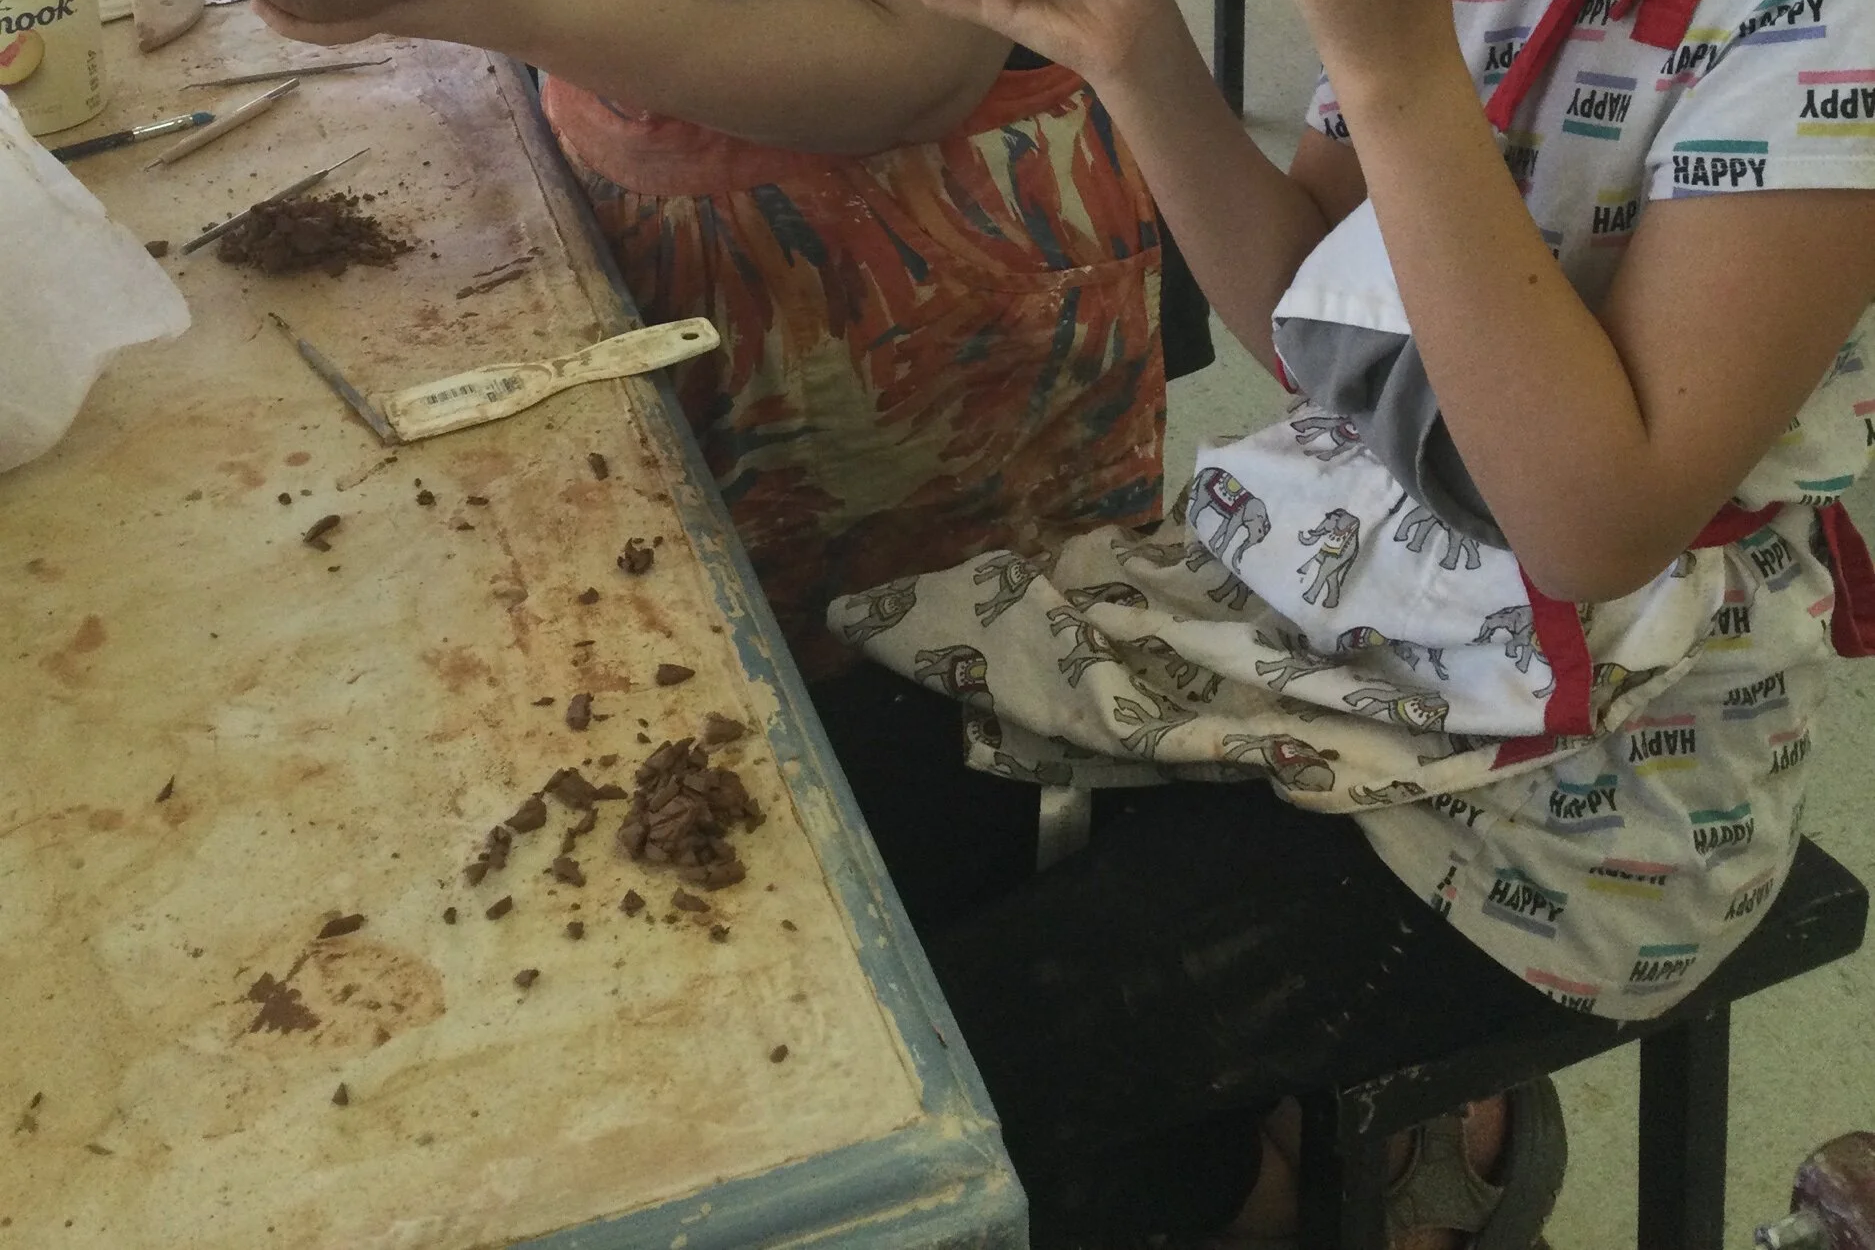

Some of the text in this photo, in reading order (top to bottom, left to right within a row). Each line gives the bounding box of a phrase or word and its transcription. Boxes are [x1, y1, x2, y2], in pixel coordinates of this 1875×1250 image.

[1567, 88, 1632, 122] HAPPY
[1800, 88, 1875, 118] APPY
[1672, 155, 1766, 187] HAPPY
[1592, 199, 1640, 234] HAP
[1430, 792, 1485, 827] PPY
[1488, 879, 1564, 922] HAPPY
